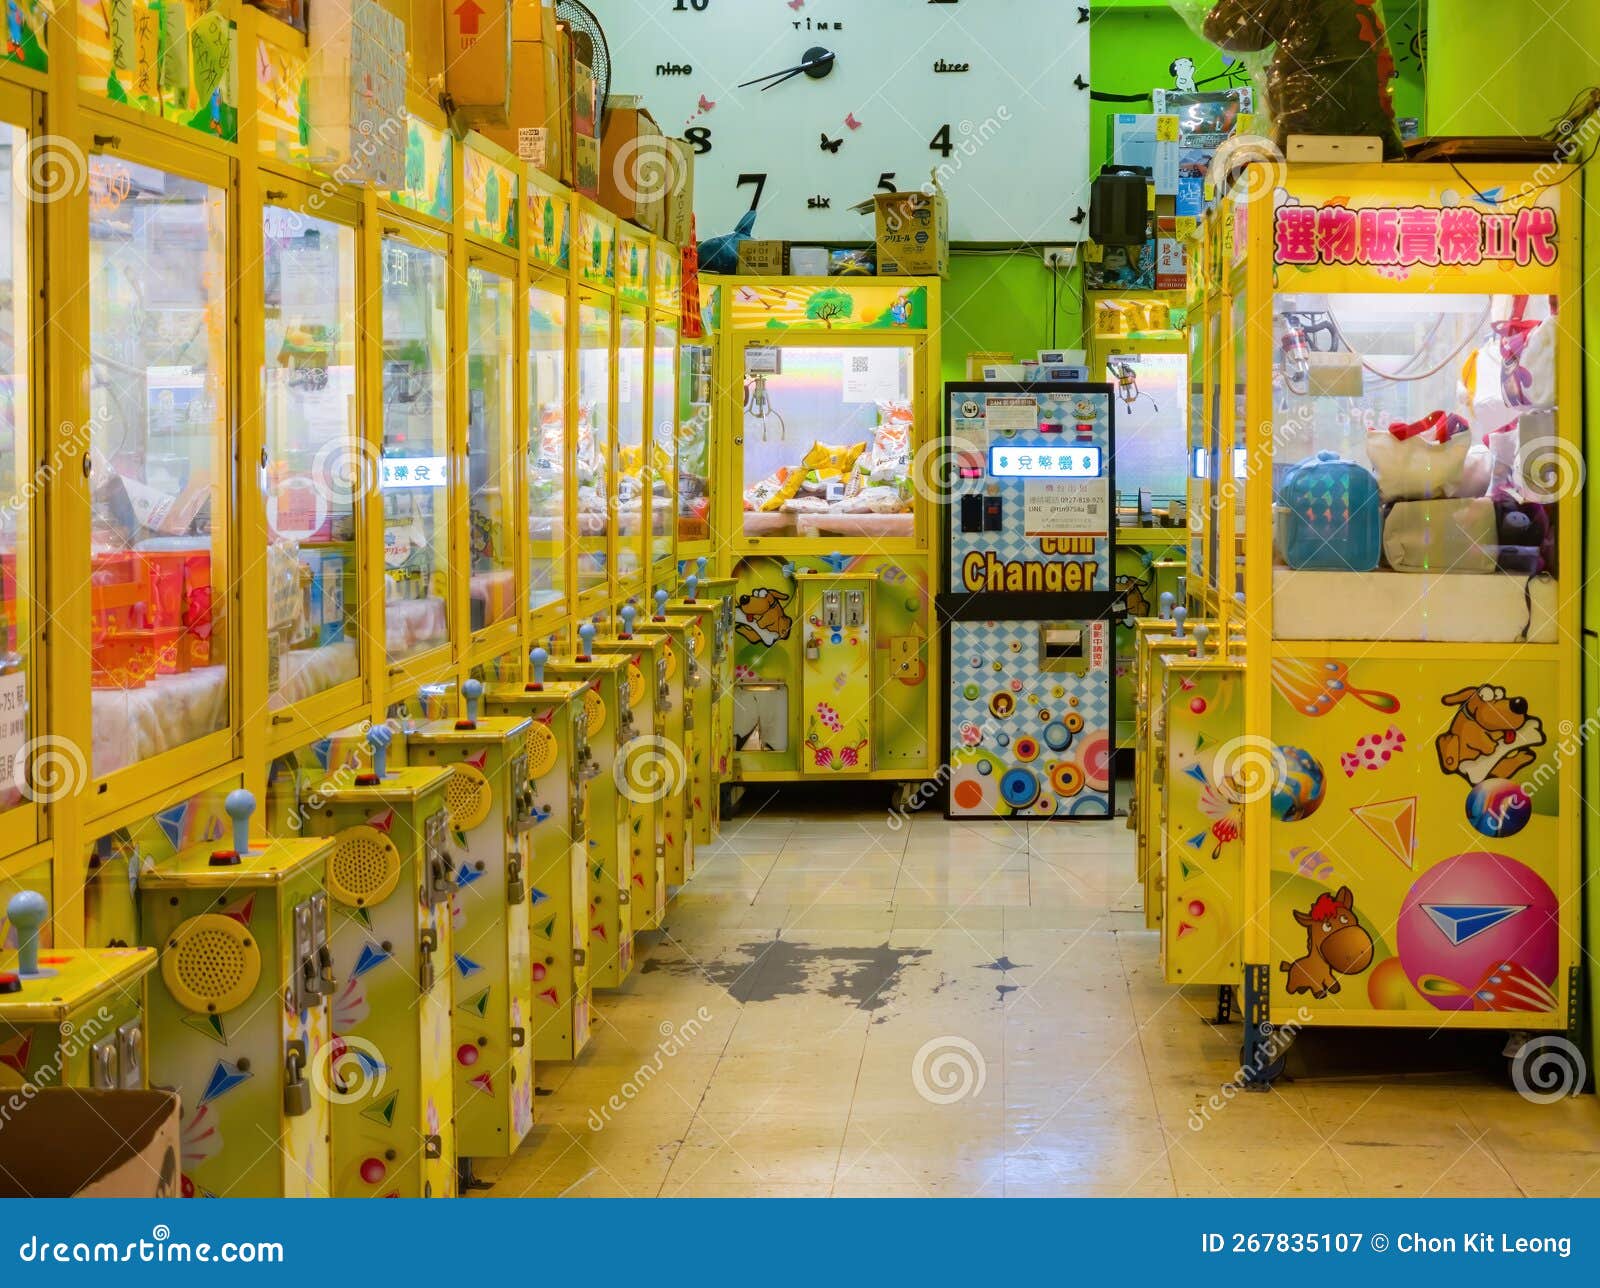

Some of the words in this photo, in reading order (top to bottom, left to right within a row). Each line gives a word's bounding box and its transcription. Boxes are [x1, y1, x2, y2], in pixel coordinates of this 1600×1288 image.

[656, 62, 692, 75] nine
[934, 58, 969, 73] three
[684, 127, 712, 154] 8
[929, 124, 953, 157] 4
[736, 173, 767, 211] 7
[877, 173, 897, 192] 5
[807, 194, 830, 209] six
[962, 550, 1099, 592] Changer
